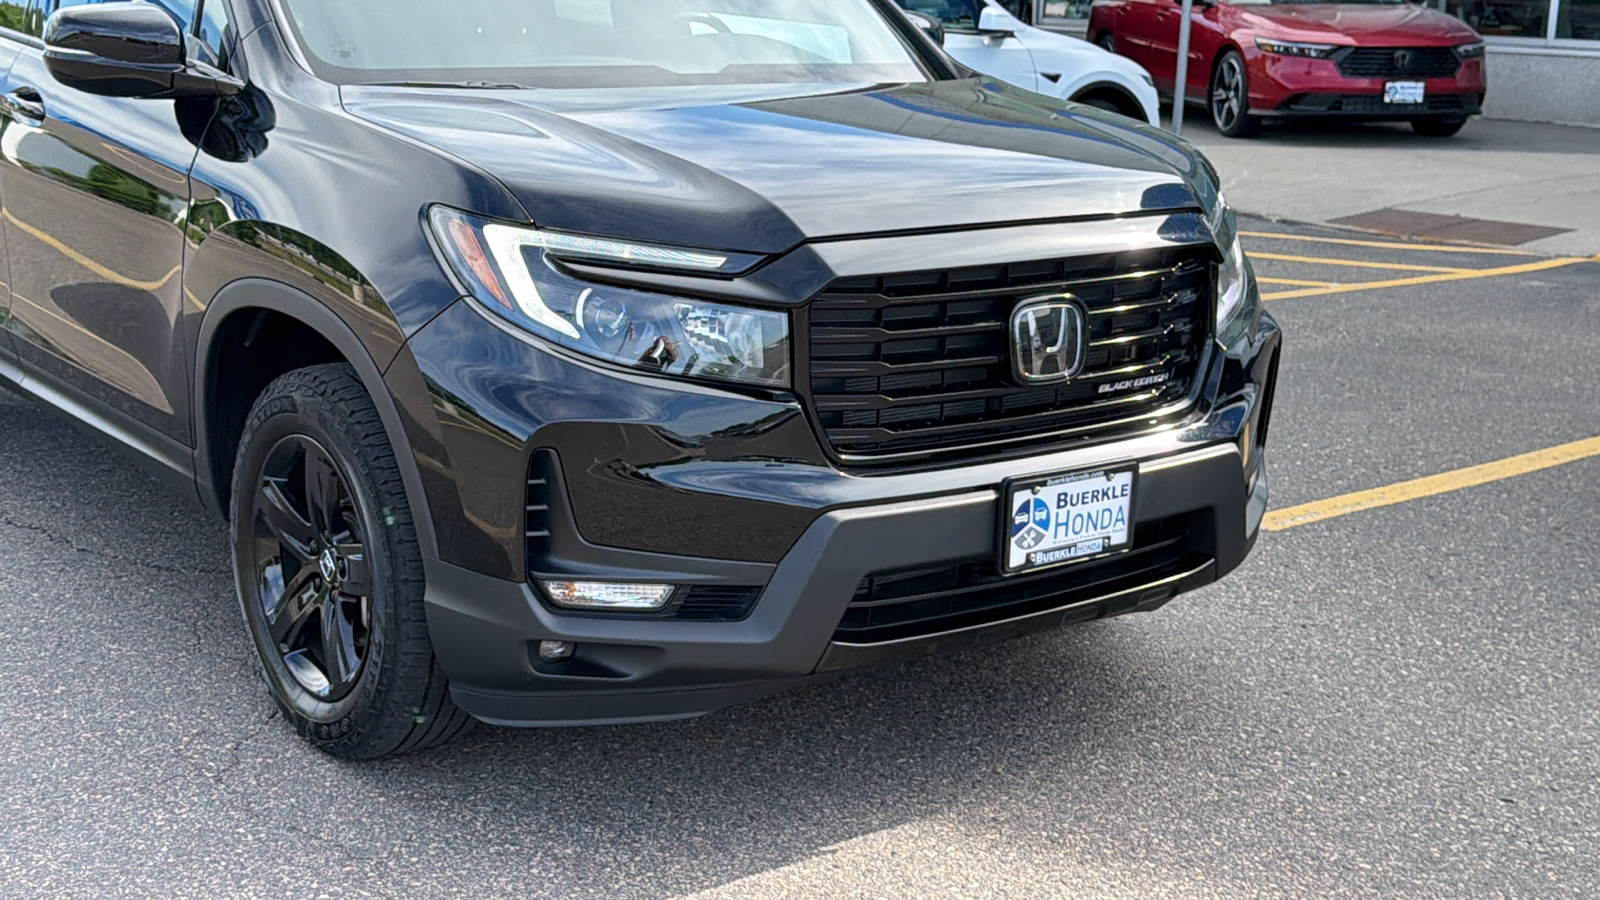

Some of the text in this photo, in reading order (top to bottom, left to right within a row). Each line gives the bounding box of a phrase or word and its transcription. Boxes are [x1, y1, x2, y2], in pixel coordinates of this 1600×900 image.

[1098, 380, 1133, 394] BLACK
[1057, 484, 1129, 509] BUERKLE
[1054, 505, 1125, 539] HONDA
[1036, 543, 1101, 563] BUERKLE HONDA
